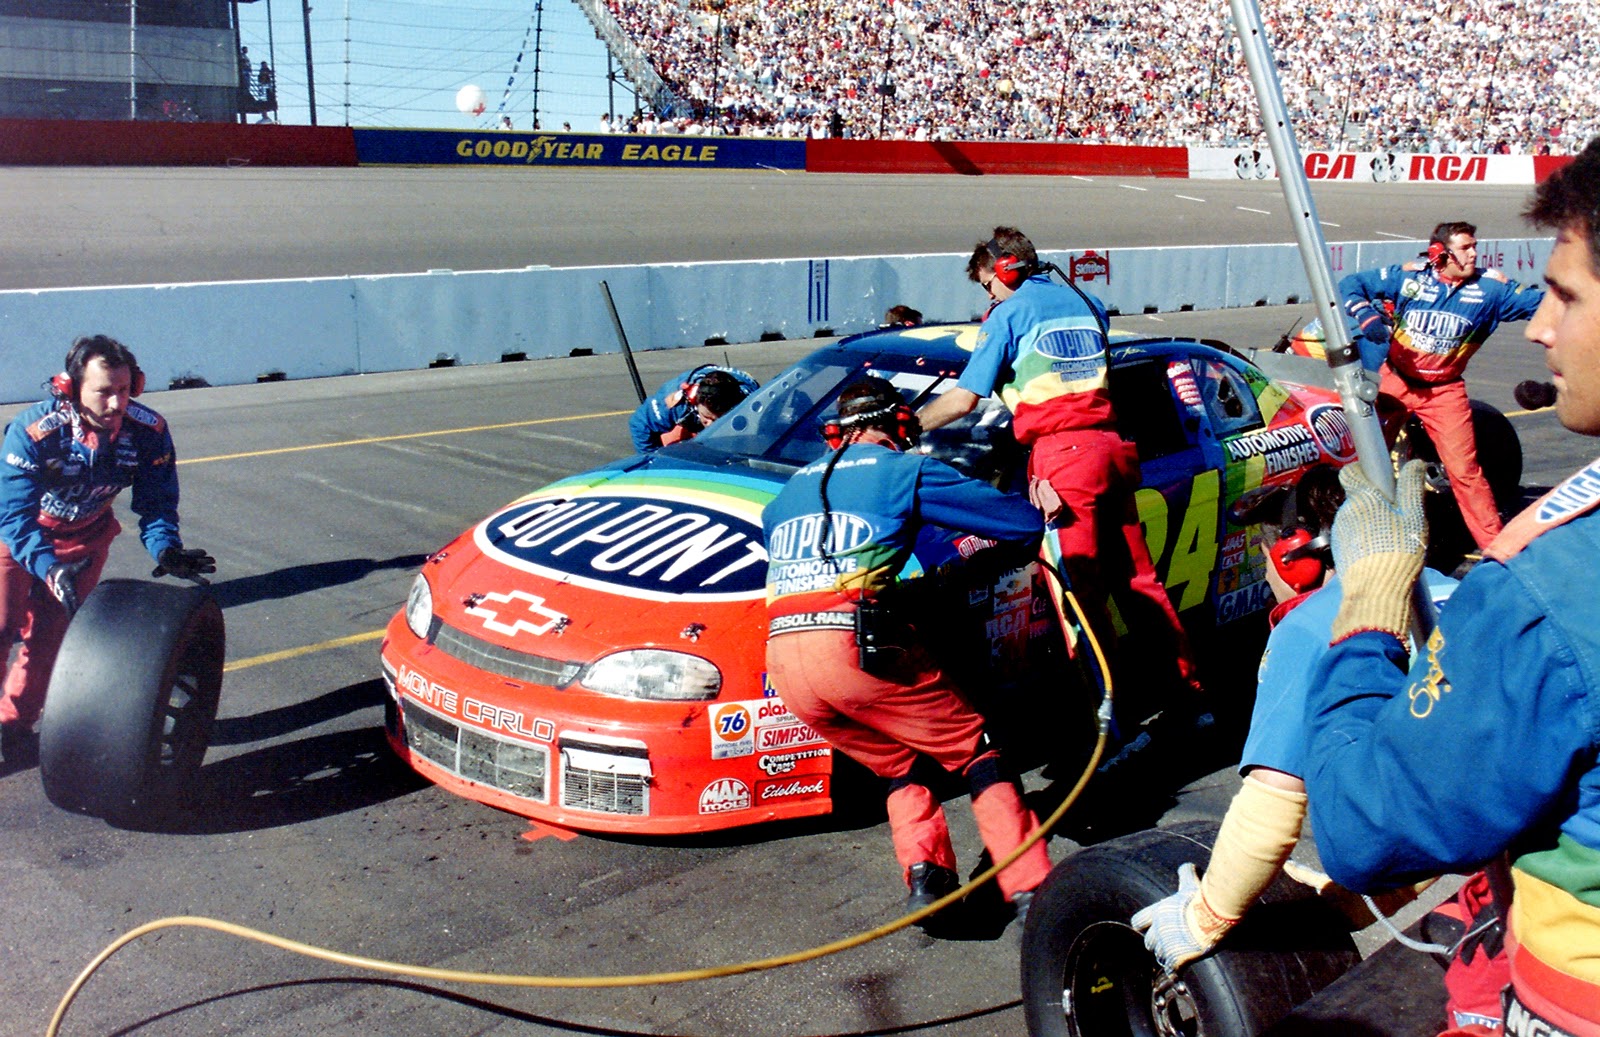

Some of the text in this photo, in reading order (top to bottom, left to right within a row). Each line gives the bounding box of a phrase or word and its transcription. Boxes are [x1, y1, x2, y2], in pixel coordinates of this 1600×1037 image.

[621, 144, 718, 161] EAGLE
[1275, 153, 1356, 179] CA
[1408, 155, 1488, 181] RCA
[1226, 423, 1314, 461] AUTOMOTIVE
[1265, 441, 1320, 476] FINISHES
[775, 573, 837, 596] FINISHES
[397, 664, 556, 742] MONTE CARLO
[758, 701, 790, 720] plas
[719, 711, 747, 736] 76
[762, 725, 823, 747] SIMPSO
[758, 748, 831, 770] COMPETITION
[702, 780, 748, 804] MAC
[761, 779, 824, 799] Edelbrock
[701, 800, 748, 812] TOOLS
